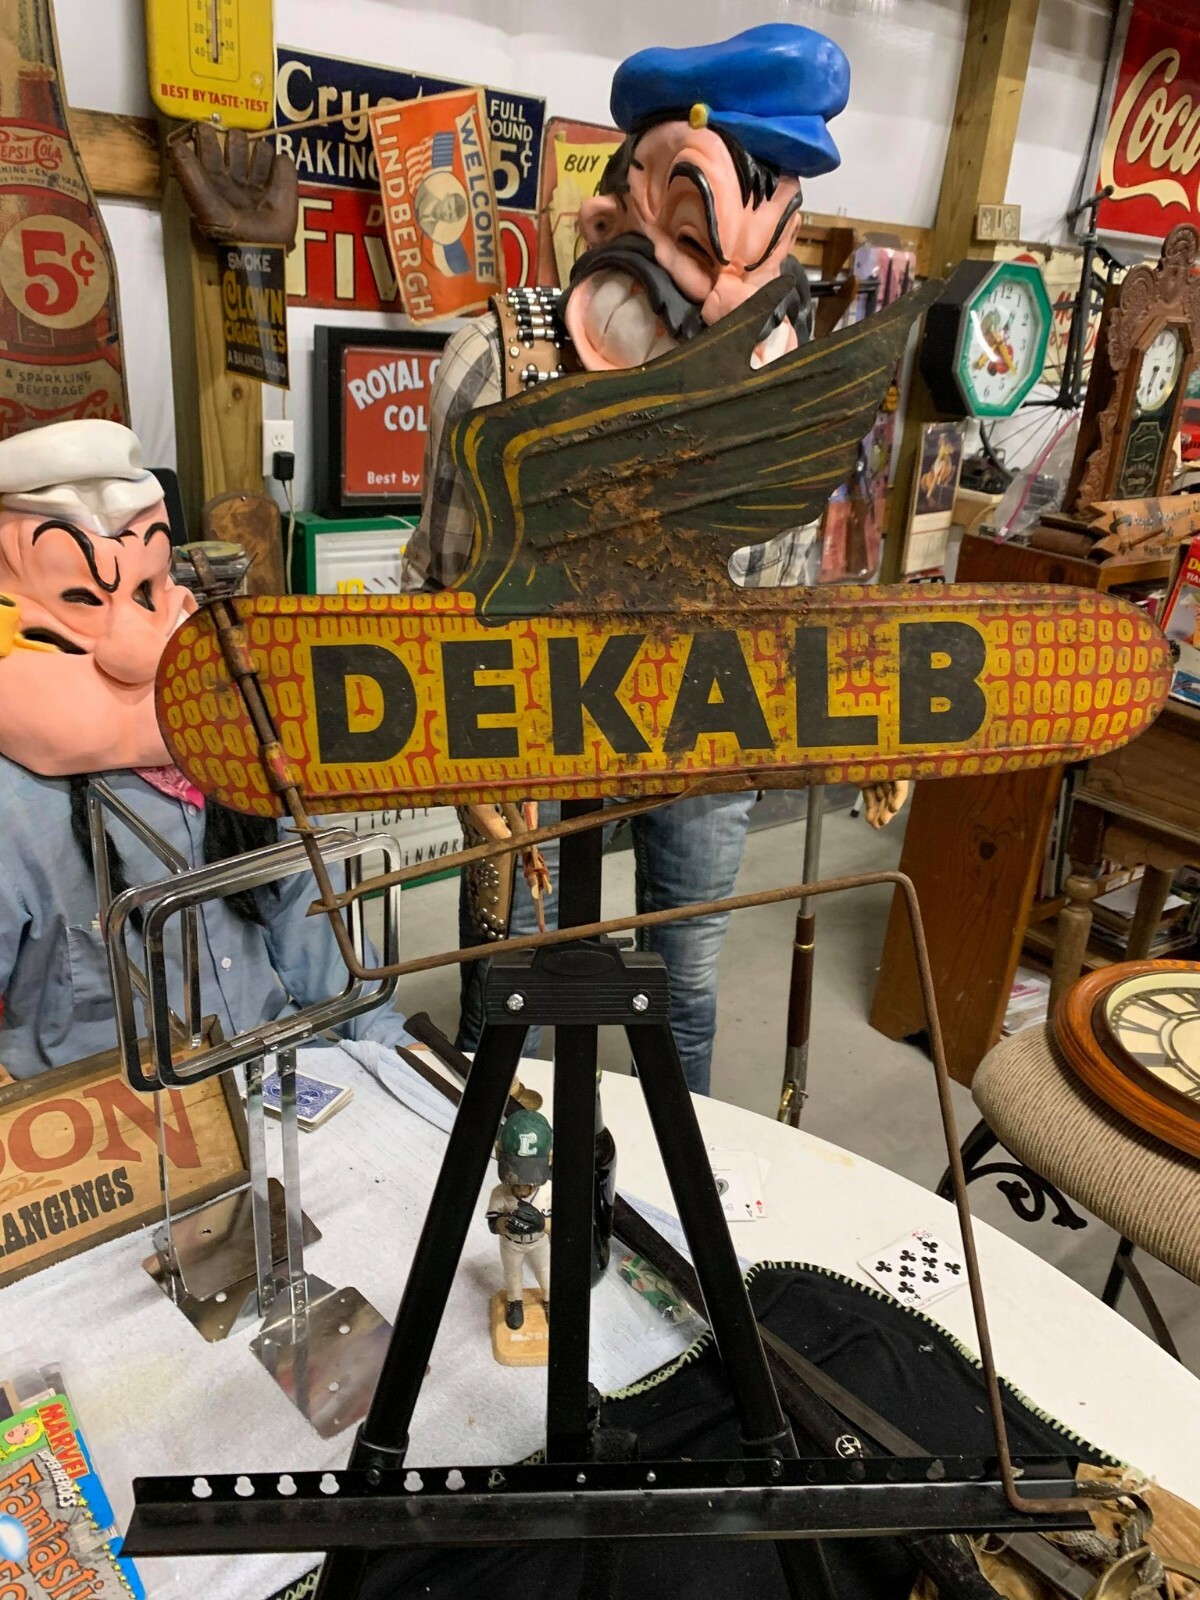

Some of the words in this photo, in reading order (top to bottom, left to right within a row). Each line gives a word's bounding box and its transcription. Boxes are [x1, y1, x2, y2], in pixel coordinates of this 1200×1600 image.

[161, 83, 189, 99] BEST
[193, 89, 206, 102] BY
[208, 91, 269, 113] TASTE-TEST
[490, 99, 526, 123] FULL
[488, 118, 533, 142] OUND
[564, 154, 600, 173] BUY
[374, 113, 435, 315] LINDBERGH
[459, 115, 496, 278] WELCOME
[21, 229, 96, 316] 5¢
[227, 251, 272, 273] SMOKE
[222, 270, 283, 325] CLOWN
[224, 320, 286, 355] CIGARETTES
[5, 368, 13, 379] A
[19, 371, 92, 384] SPARKLING
[16, 383, 85, 396] BEVERAGE
[348, 357, 425, 411] ROYAL
[384, 405, 428, 432] COL
[367, 471, 397, 484] Best
[402, 471, 420, 487] by
[309, 620, 988, 766] DEKALB
[0, 1055, 202, 1174] ON
[0, 1166, 134, 1256] ANGINGS
[37, 1402, 91, 1480] MARVEL
[50, 1466, 77, 1509] HEROES
[0, 1459, 104, 1600] Fantasti
